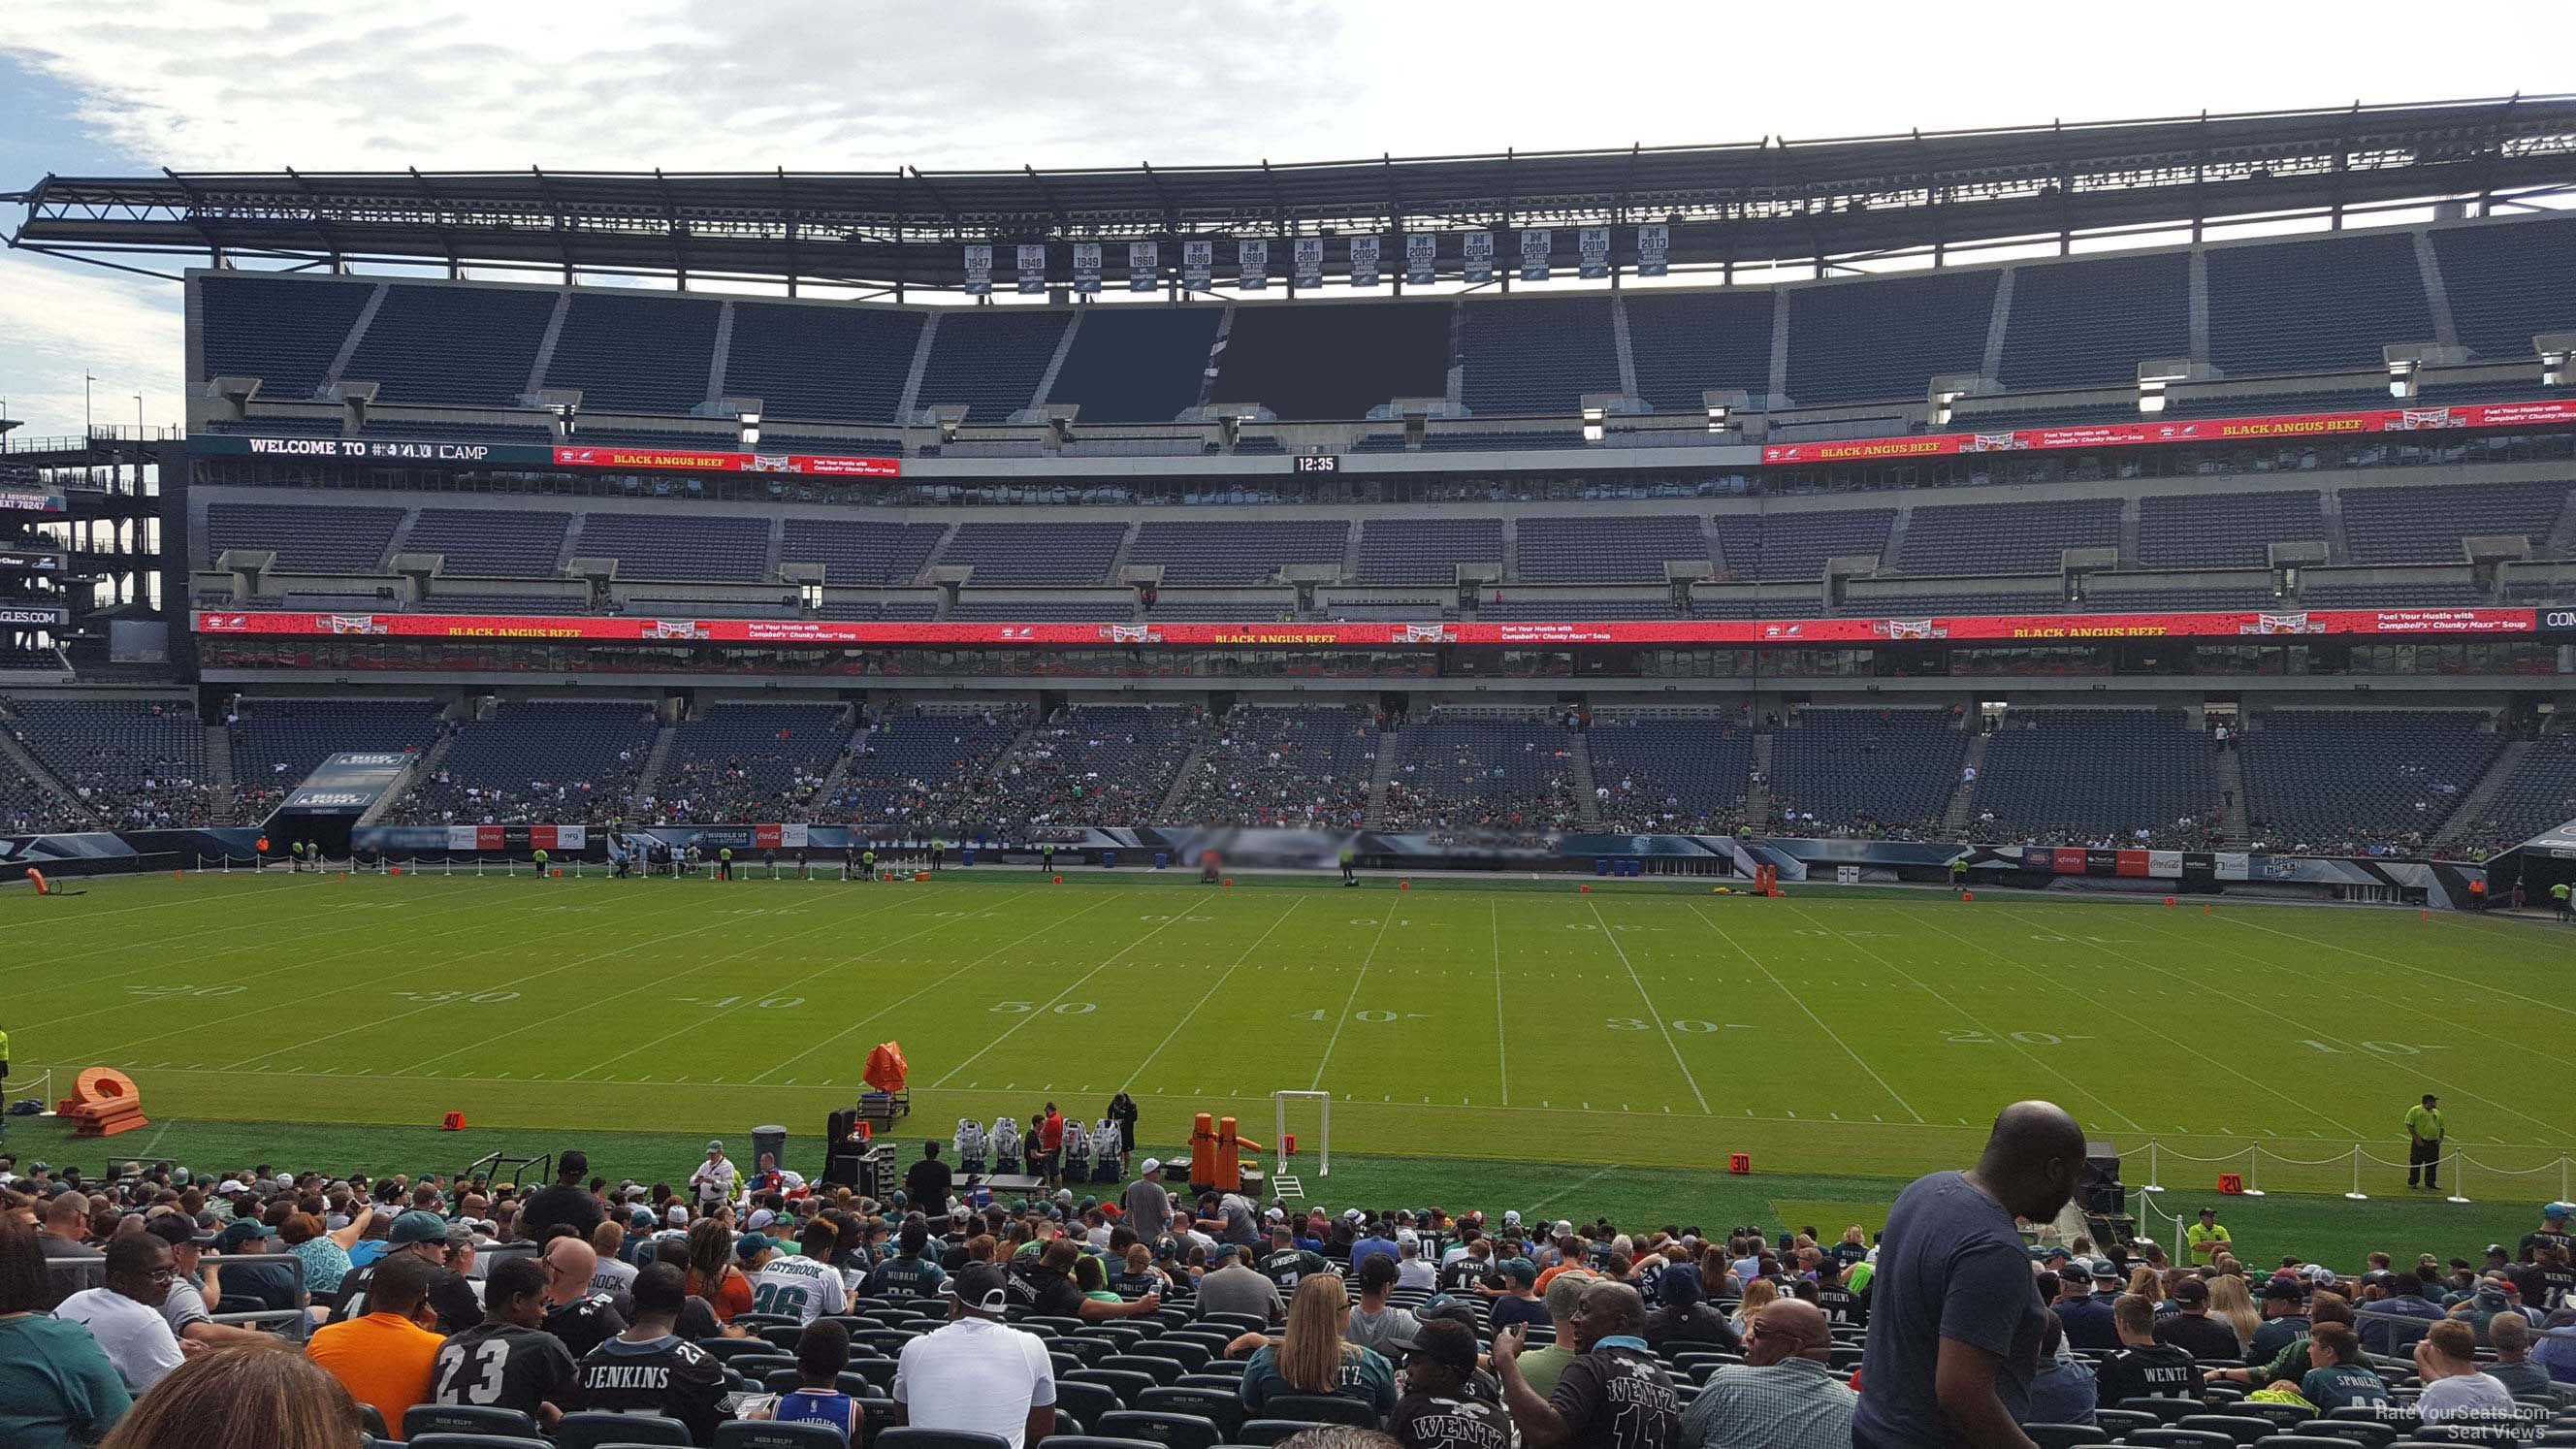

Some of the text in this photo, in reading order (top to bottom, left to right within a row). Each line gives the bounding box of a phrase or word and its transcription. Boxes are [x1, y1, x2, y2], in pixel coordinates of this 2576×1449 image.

[1524, 243, 1548, 252] 2006
[1583, 242, 1606, 250] 2010
[1642, 239, 1666, 248] 2013
[1353, 249, 1377, 258] 2002
[1409, 247, 1433, 256] 2003
[1466, 245, 1491, 255] 2004
[1133, 256, 1154, 266] 1960
[1188, 253, 1208, 263] 1980
[1298, 251, 1320, 261] 2001
[969, 258, 989, 268] 1947
[1021, 258, 1042, 268] 1948
[1078, 257, 1099, 267] 1949
[2223, 419, 2363, 436] BLACK ANGUS BEEF
[249, 438, 337, 456] WELCOME
[342, 443, 366, 457] TO
[1820, 442, 1940, 458] BLACK ANGUS BEEF
[614, 455, 725, 467] BLACK ANGUS BEEF
[1299, 457, 1334, 471] 12:35
[0, 612, 55, 624] GLES.COM
[2502, 621, 2528, 629] Soup
[2058, 856, 2081, 865] xfinity
[2150, 859, 2180, 869] Coca-Cola
[988, 1001, 1097, 1014] 50
[1291, 1009, 1398, 1023] 40
[1605, 1017, 1720, 1033] 30
[1939, 1029, 2063, 1046] 20
[1732, 1155, 1750, 1173] 30
[2223, 1175, 2242, 1194] 20
[1271, 1253, 1301, 1270] JAWORSKI
[1457, 1262, 1485, 1272] WENTZ
[886, 1271, 918, 1282] MURRAY
[2544, 1272, 2573, 1283] WENTZ
[1115, 1282, 1143, 1293] SPROLES
[435, 1338, 510, 1405] 23
[2143, 1367, 2189, 1383] WENTZ
[584, 1365, 670, 1390] JENKINS
[1605, 1376, 1677, 1414] WENTZ
